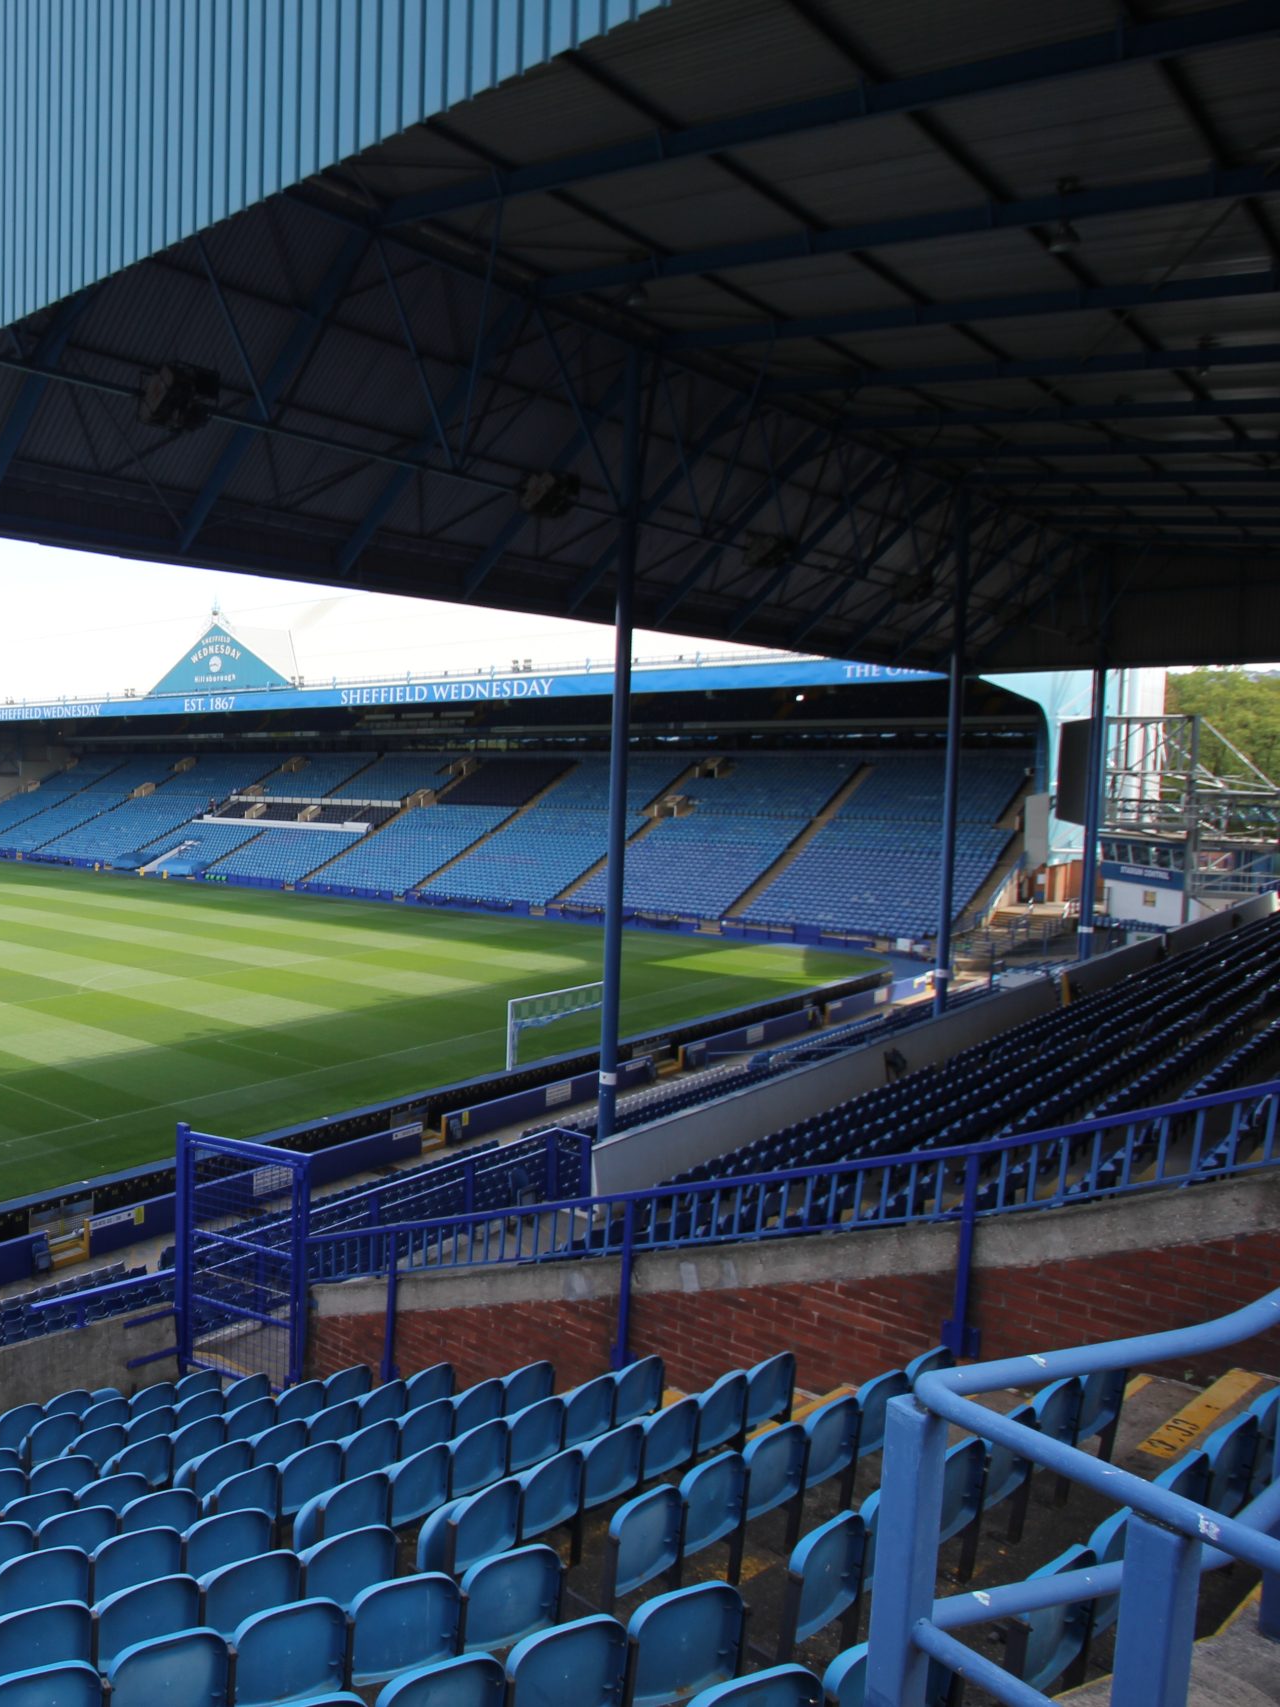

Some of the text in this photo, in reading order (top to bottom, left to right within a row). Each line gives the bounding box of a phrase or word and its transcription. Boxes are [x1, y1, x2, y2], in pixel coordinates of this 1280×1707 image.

[190, 644, 241, 664] WEDNESDAY
[194, 673, 236, 683] Hillsborough
[842, 664, 880, 678] THE
[340, 678, 554, 705] SHEFFIELD WEDNESDAY
[43, 704, 102, 719] WEDNESDAY
[184, 696, 236, 712] EST. 1867
